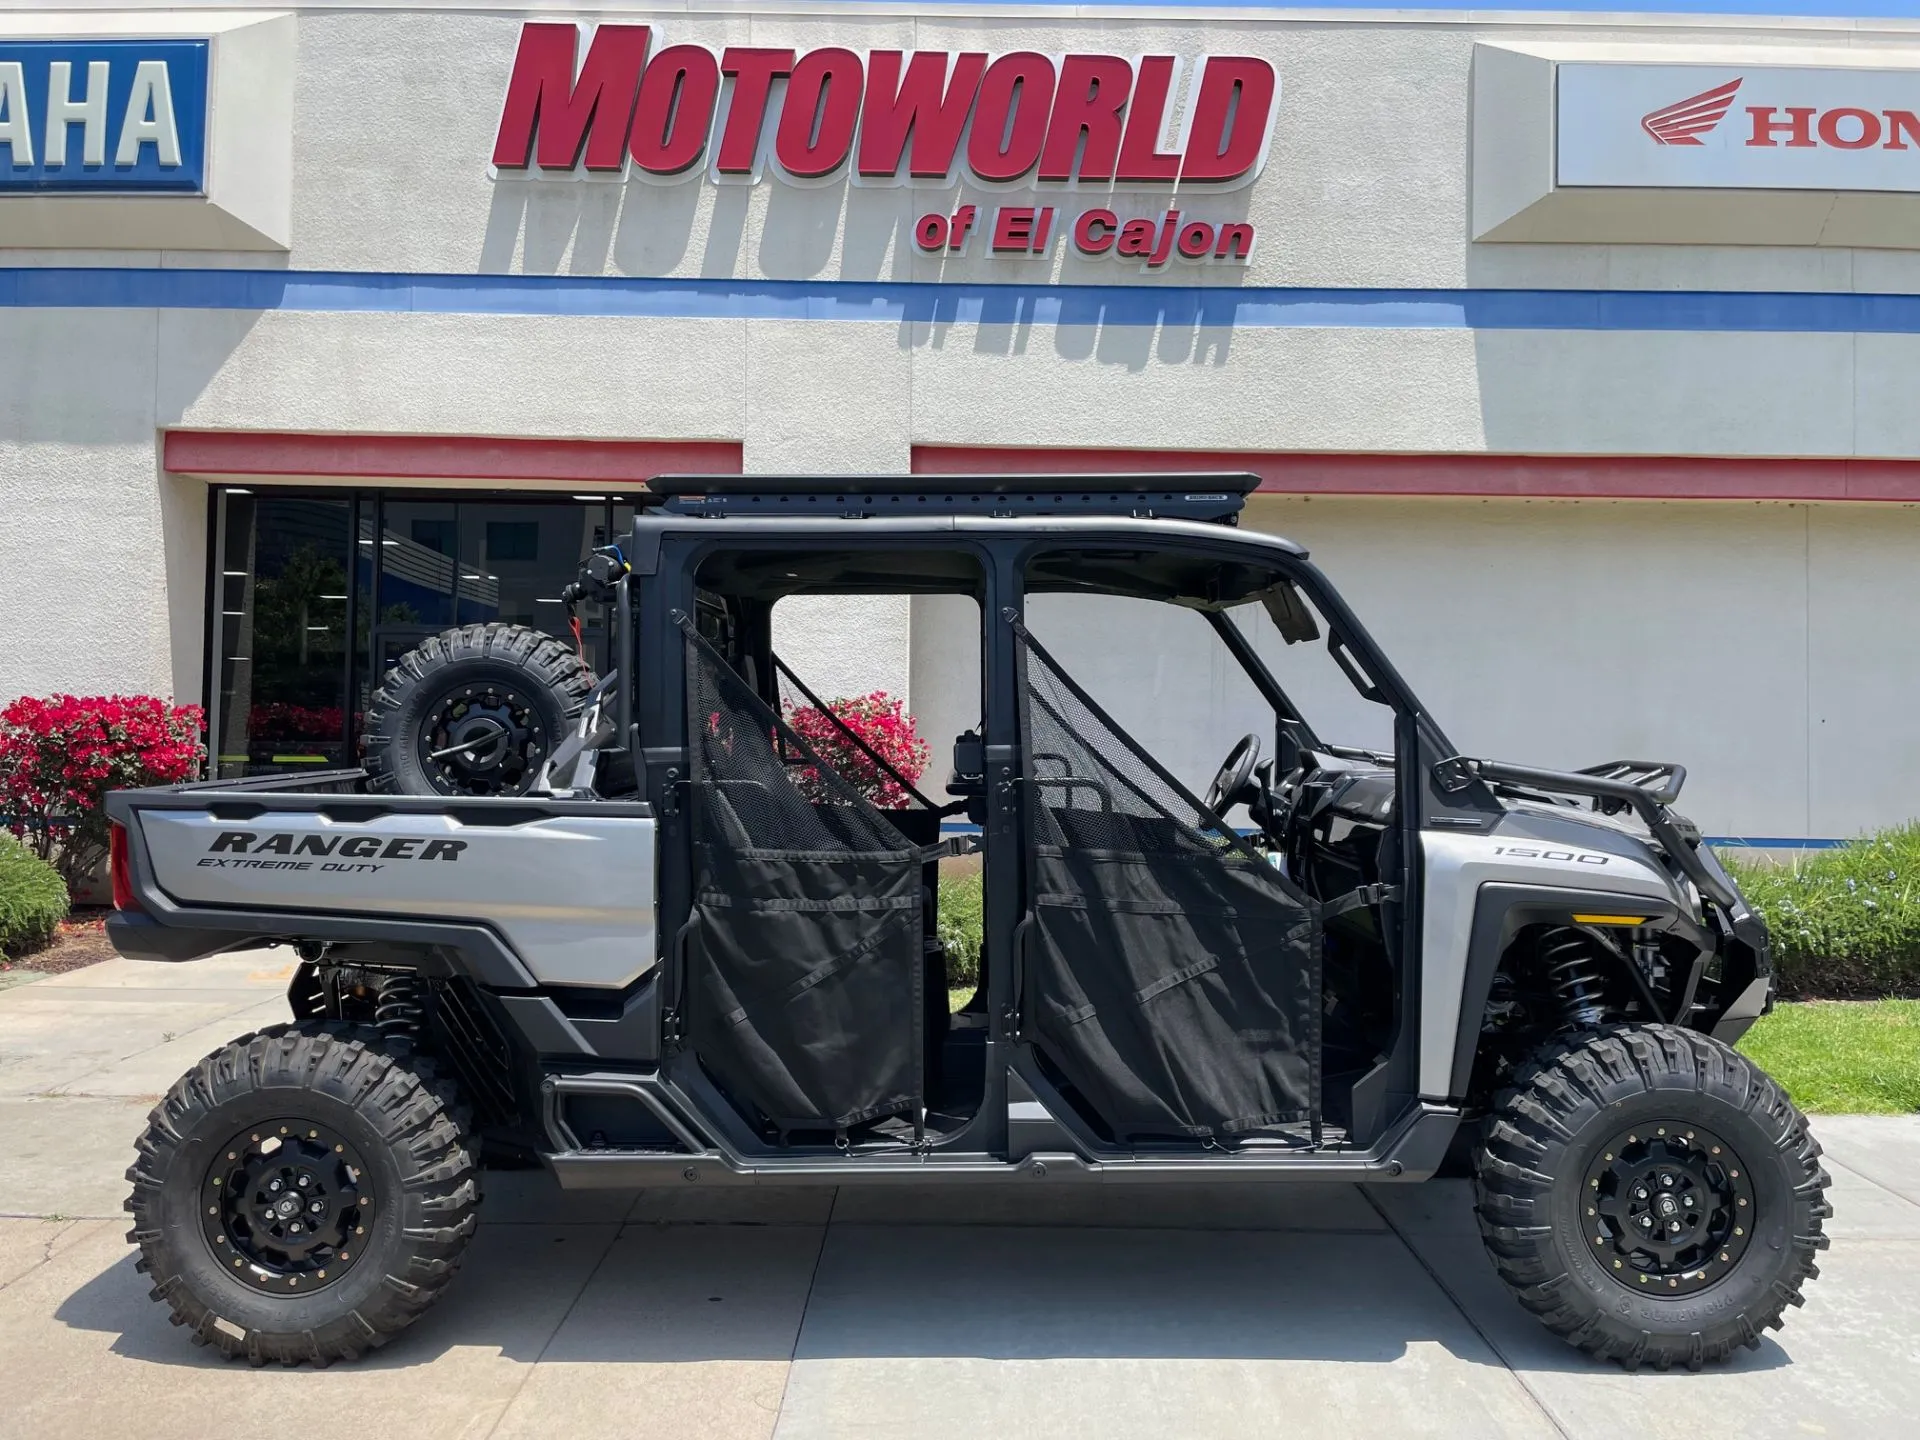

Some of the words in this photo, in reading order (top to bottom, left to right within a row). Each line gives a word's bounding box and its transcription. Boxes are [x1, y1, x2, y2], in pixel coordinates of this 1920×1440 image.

[493, 22, 1275, 182] MOTOWORLD
[915, 205, 976, 251] of
[992, 206, 1055, 254] El
[1074, 208, 1255, 267] Cajon
[207, 831, 469, 861] RANGER
[1494, 846, 1609, 865] 1500
[196, 858, 314, 871] EXTREME
[320, 863, 386, 873] DUTY
